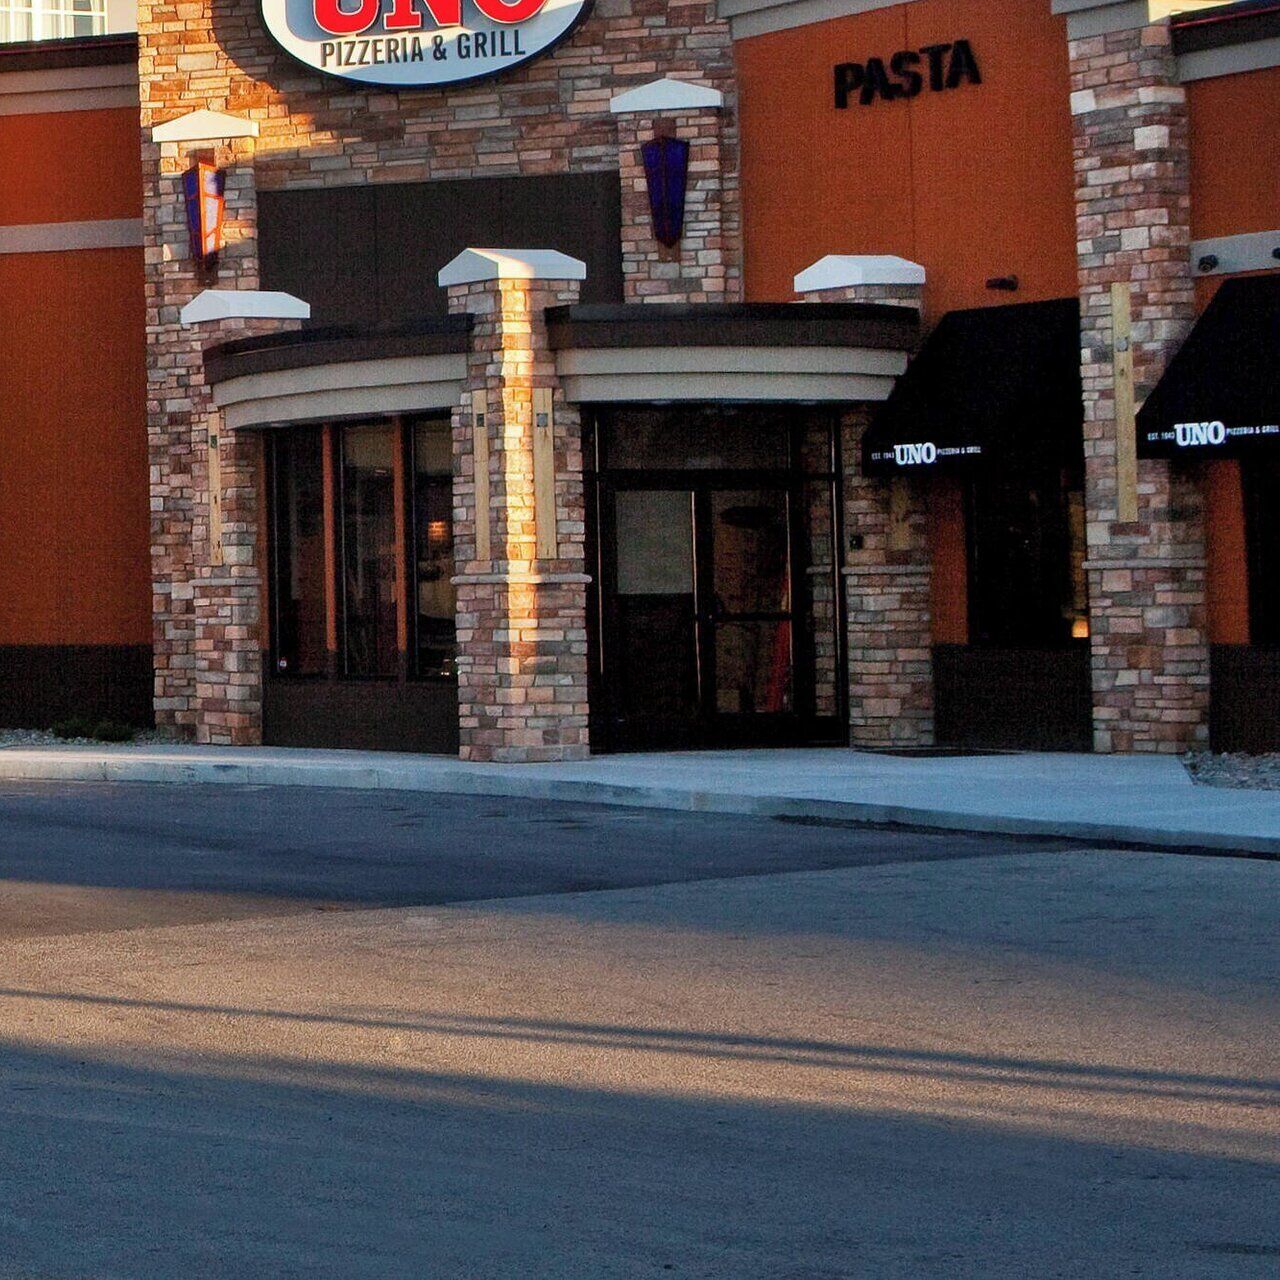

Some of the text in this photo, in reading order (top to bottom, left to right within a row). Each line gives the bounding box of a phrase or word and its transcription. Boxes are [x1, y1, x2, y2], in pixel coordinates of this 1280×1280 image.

[321, 29, 527, 68] PIZZERIA & GRILL
[834, 39, 982, 109] PASTA
[1174, 421, 1225, 446] UNO
[893, 442, 936, 465] UNO
